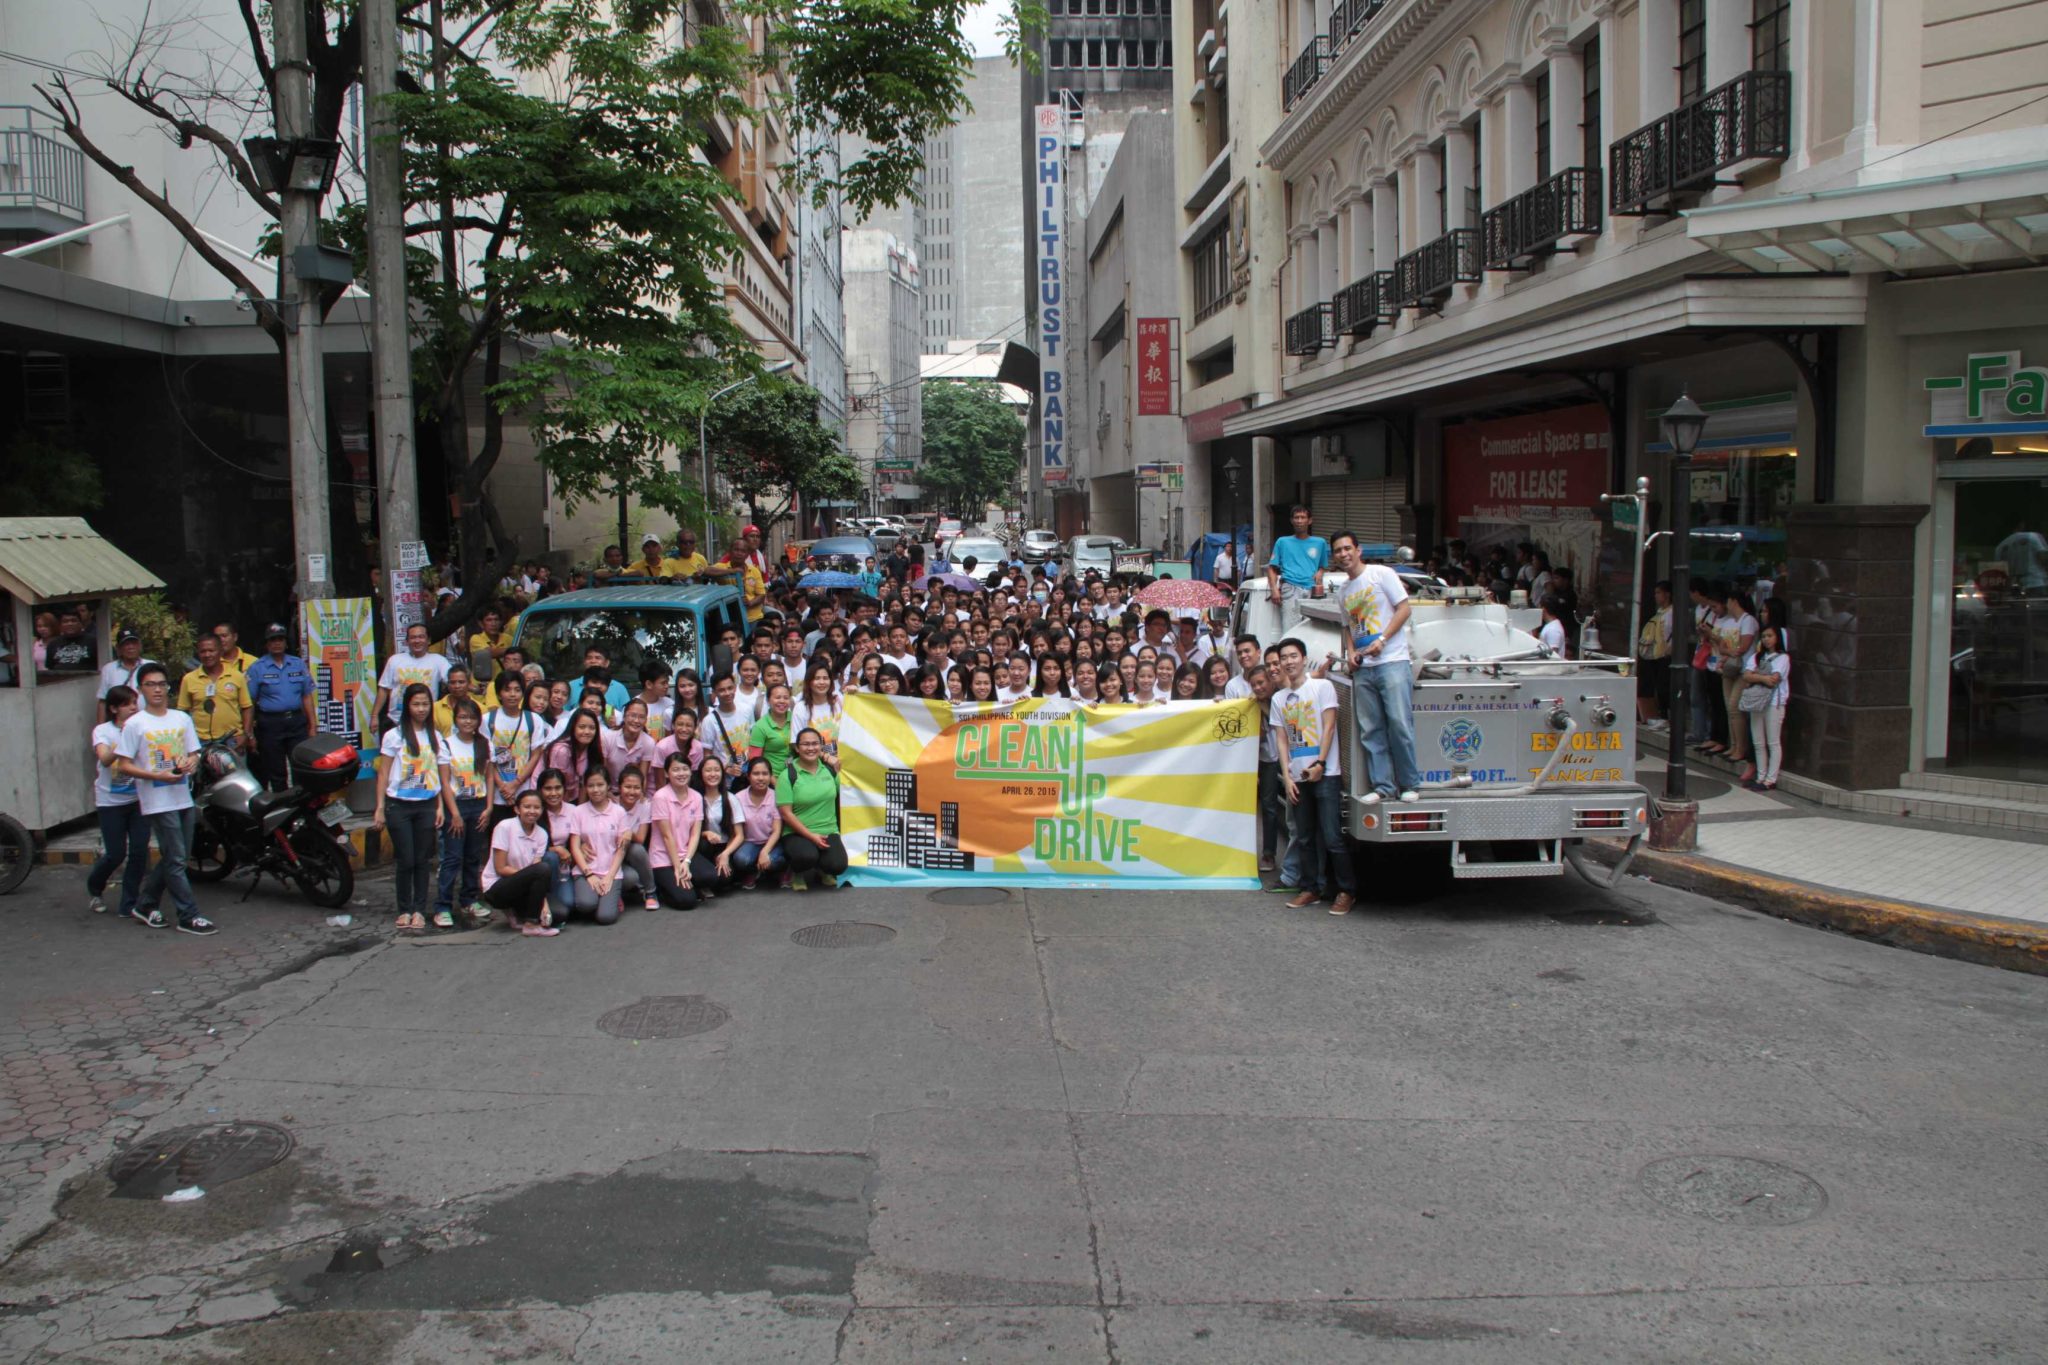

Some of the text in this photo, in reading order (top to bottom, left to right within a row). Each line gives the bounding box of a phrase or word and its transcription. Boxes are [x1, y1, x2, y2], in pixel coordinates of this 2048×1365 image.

[1039, 137, 1061, 357] PHILTRUST
[1967, 354, 2046, 417] Fa
[1043, 371, 1063, 466] BANK
[1480, 430, 1580, 457] Commercial Space
[1489, 468, 1568, 499] FOR LEASE
[972, 711, 1014, 721] PHILIPPINES
[1015, 711, 1039, 720] YOUTH
[1040, 711, 1071, 720] DIVISION
[1423, 703, 1450, 711] CRUZ
[1451, 703, 1473, 711] FIRE
[955, 724, 1070, 770] CLEAN
[1531, 731, 1624, 752] ESOLTA
[1562, 753, 1595, 764] Mini
[1426, 770, 1451, 782] OFF
[1001, 786, 1022, 796] APRIL
[1037, 786, 1057, 796] 2015
[1061, 772, 1106, 817] UP
[1035, 818, 1141, 862] DRIVE
